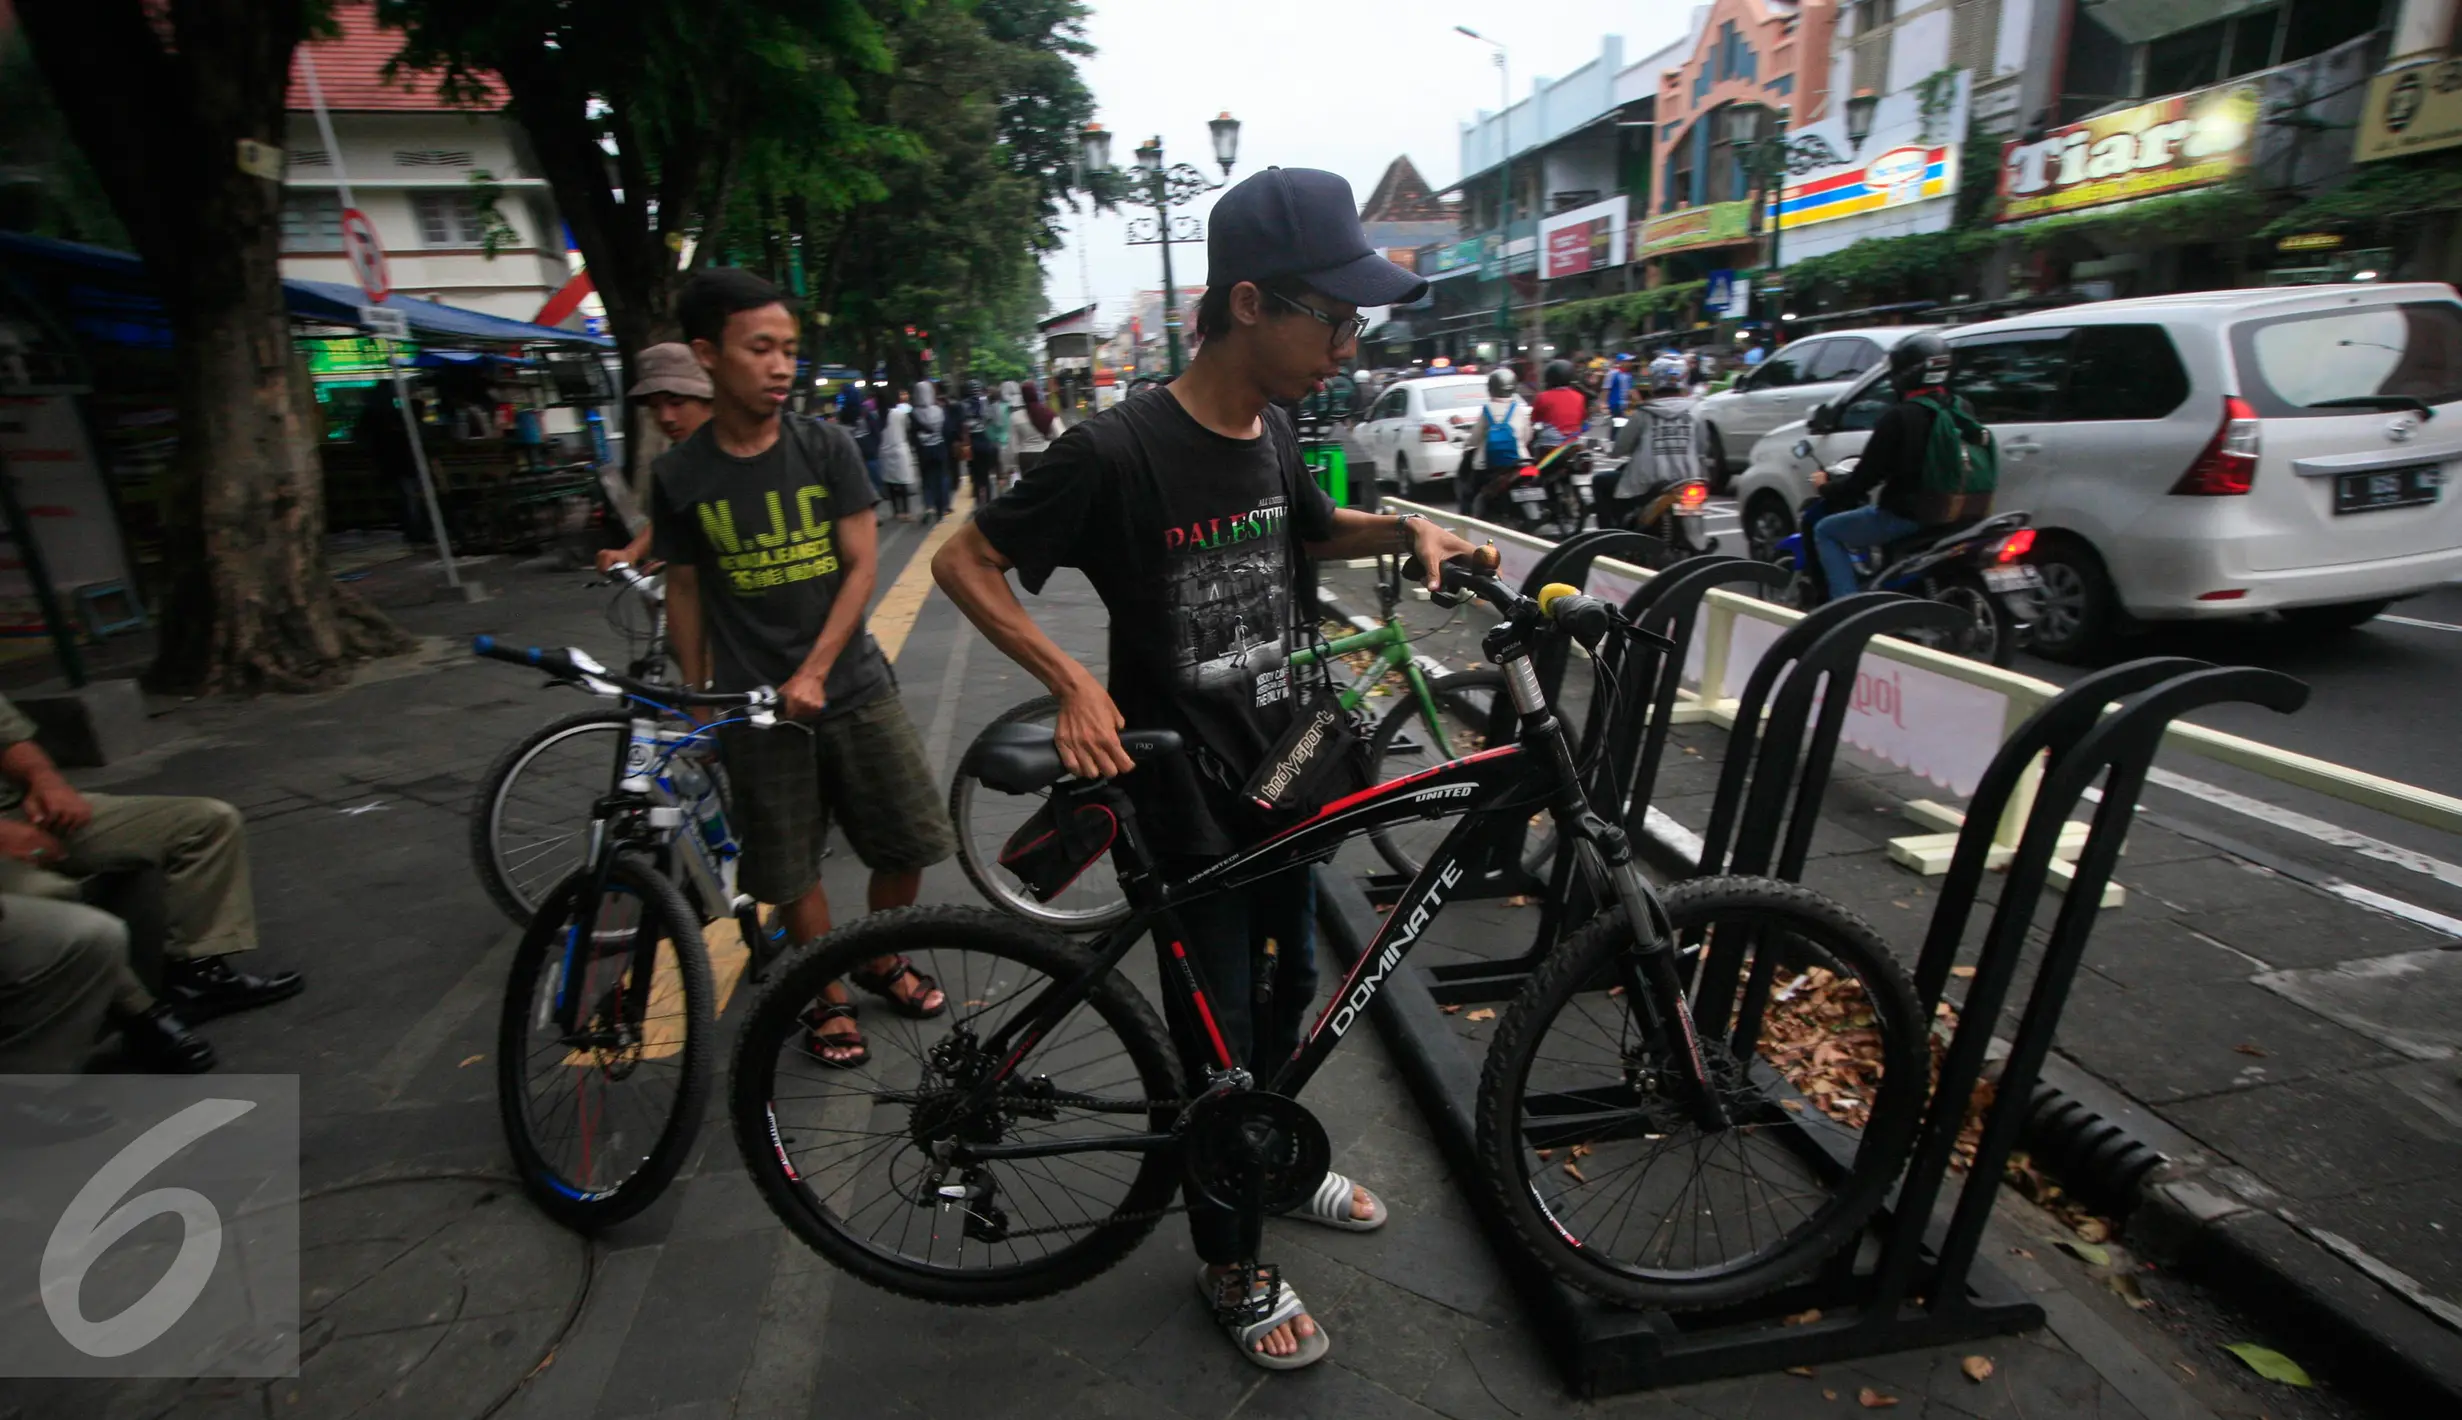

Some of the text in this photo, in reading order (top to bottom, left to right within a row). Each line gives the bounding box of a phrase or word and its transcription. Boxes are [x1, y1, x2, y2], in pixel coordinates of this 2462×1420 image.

[1261, 710, 1335, 802] bodysport
[1415, 787, 1472, 803] UNITED
[1331, 859, 1464, 1037] DOMINATE
